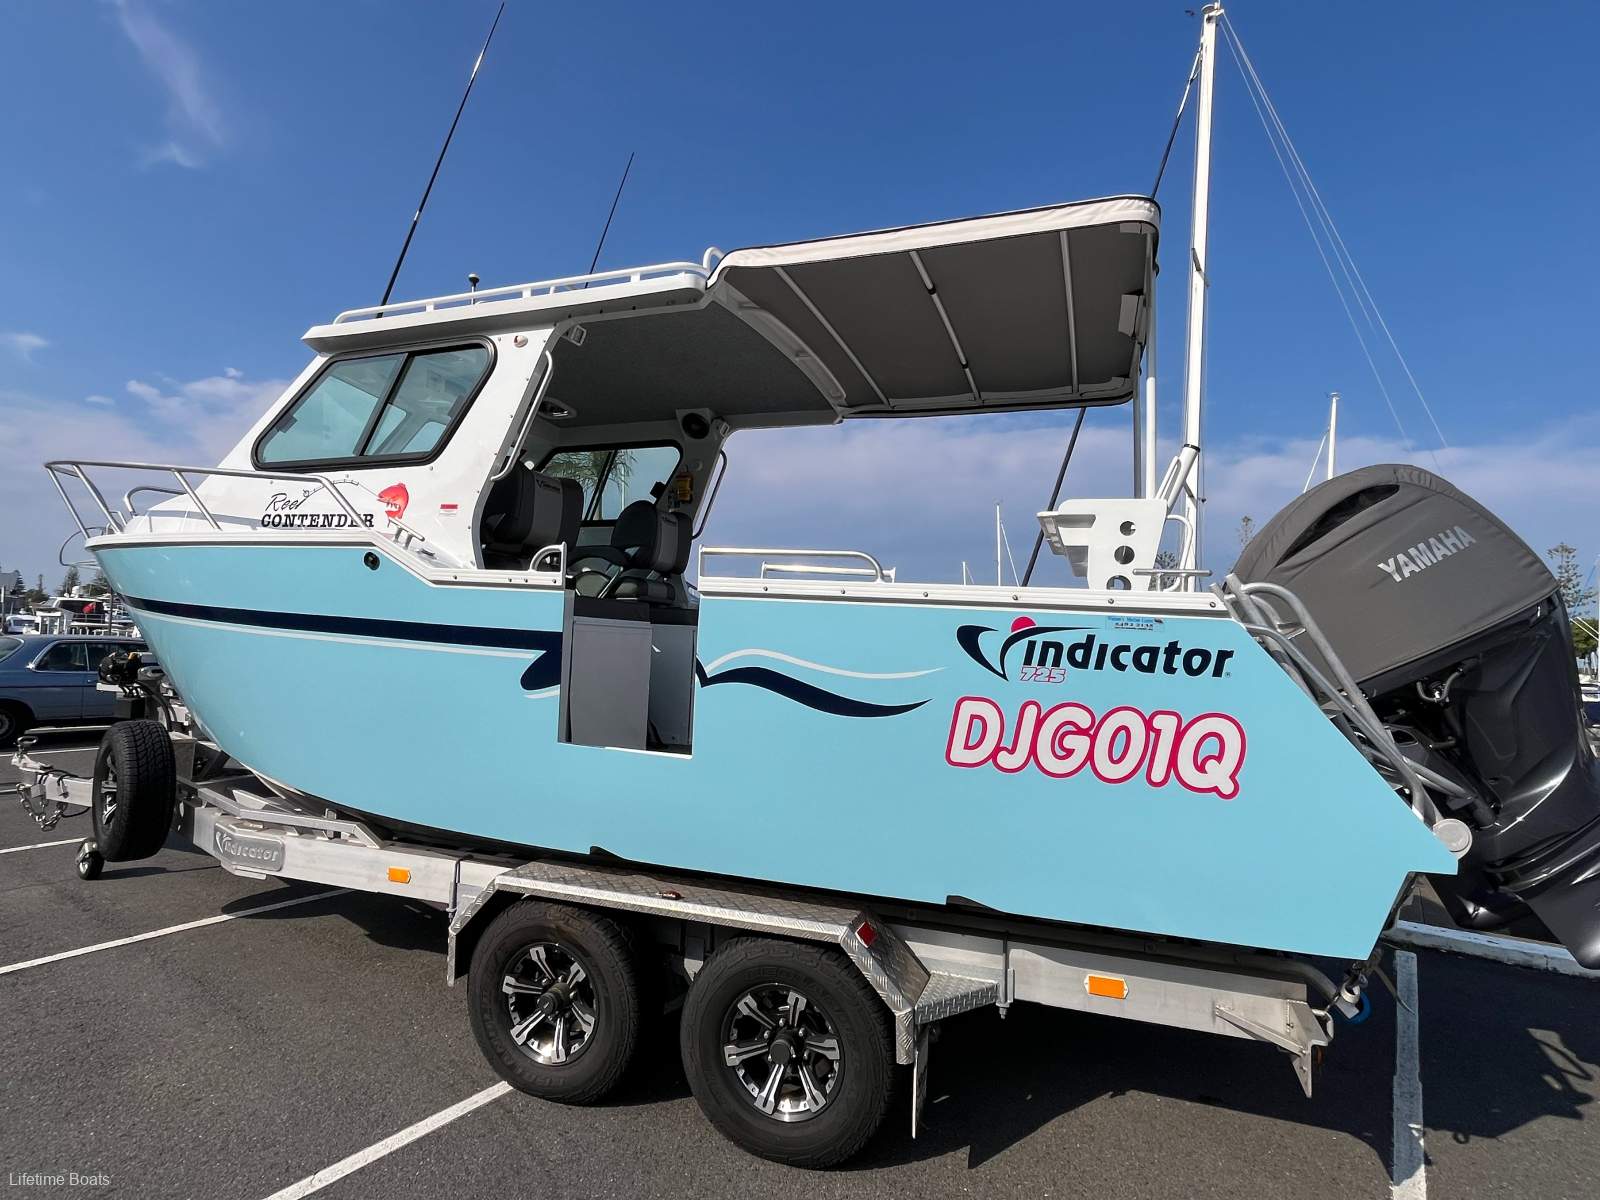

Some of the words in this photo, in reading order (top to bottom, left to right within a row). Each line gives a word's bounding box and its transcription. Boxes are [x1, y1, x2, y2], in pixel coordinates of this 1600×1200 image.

[1377, 525, 1476, 583] YAMAHA
[1020, 666, 1066, 684] 725
[1022, 633, 1234, 678] indicator
[945, 696, 1247, 800] DJG01Q
